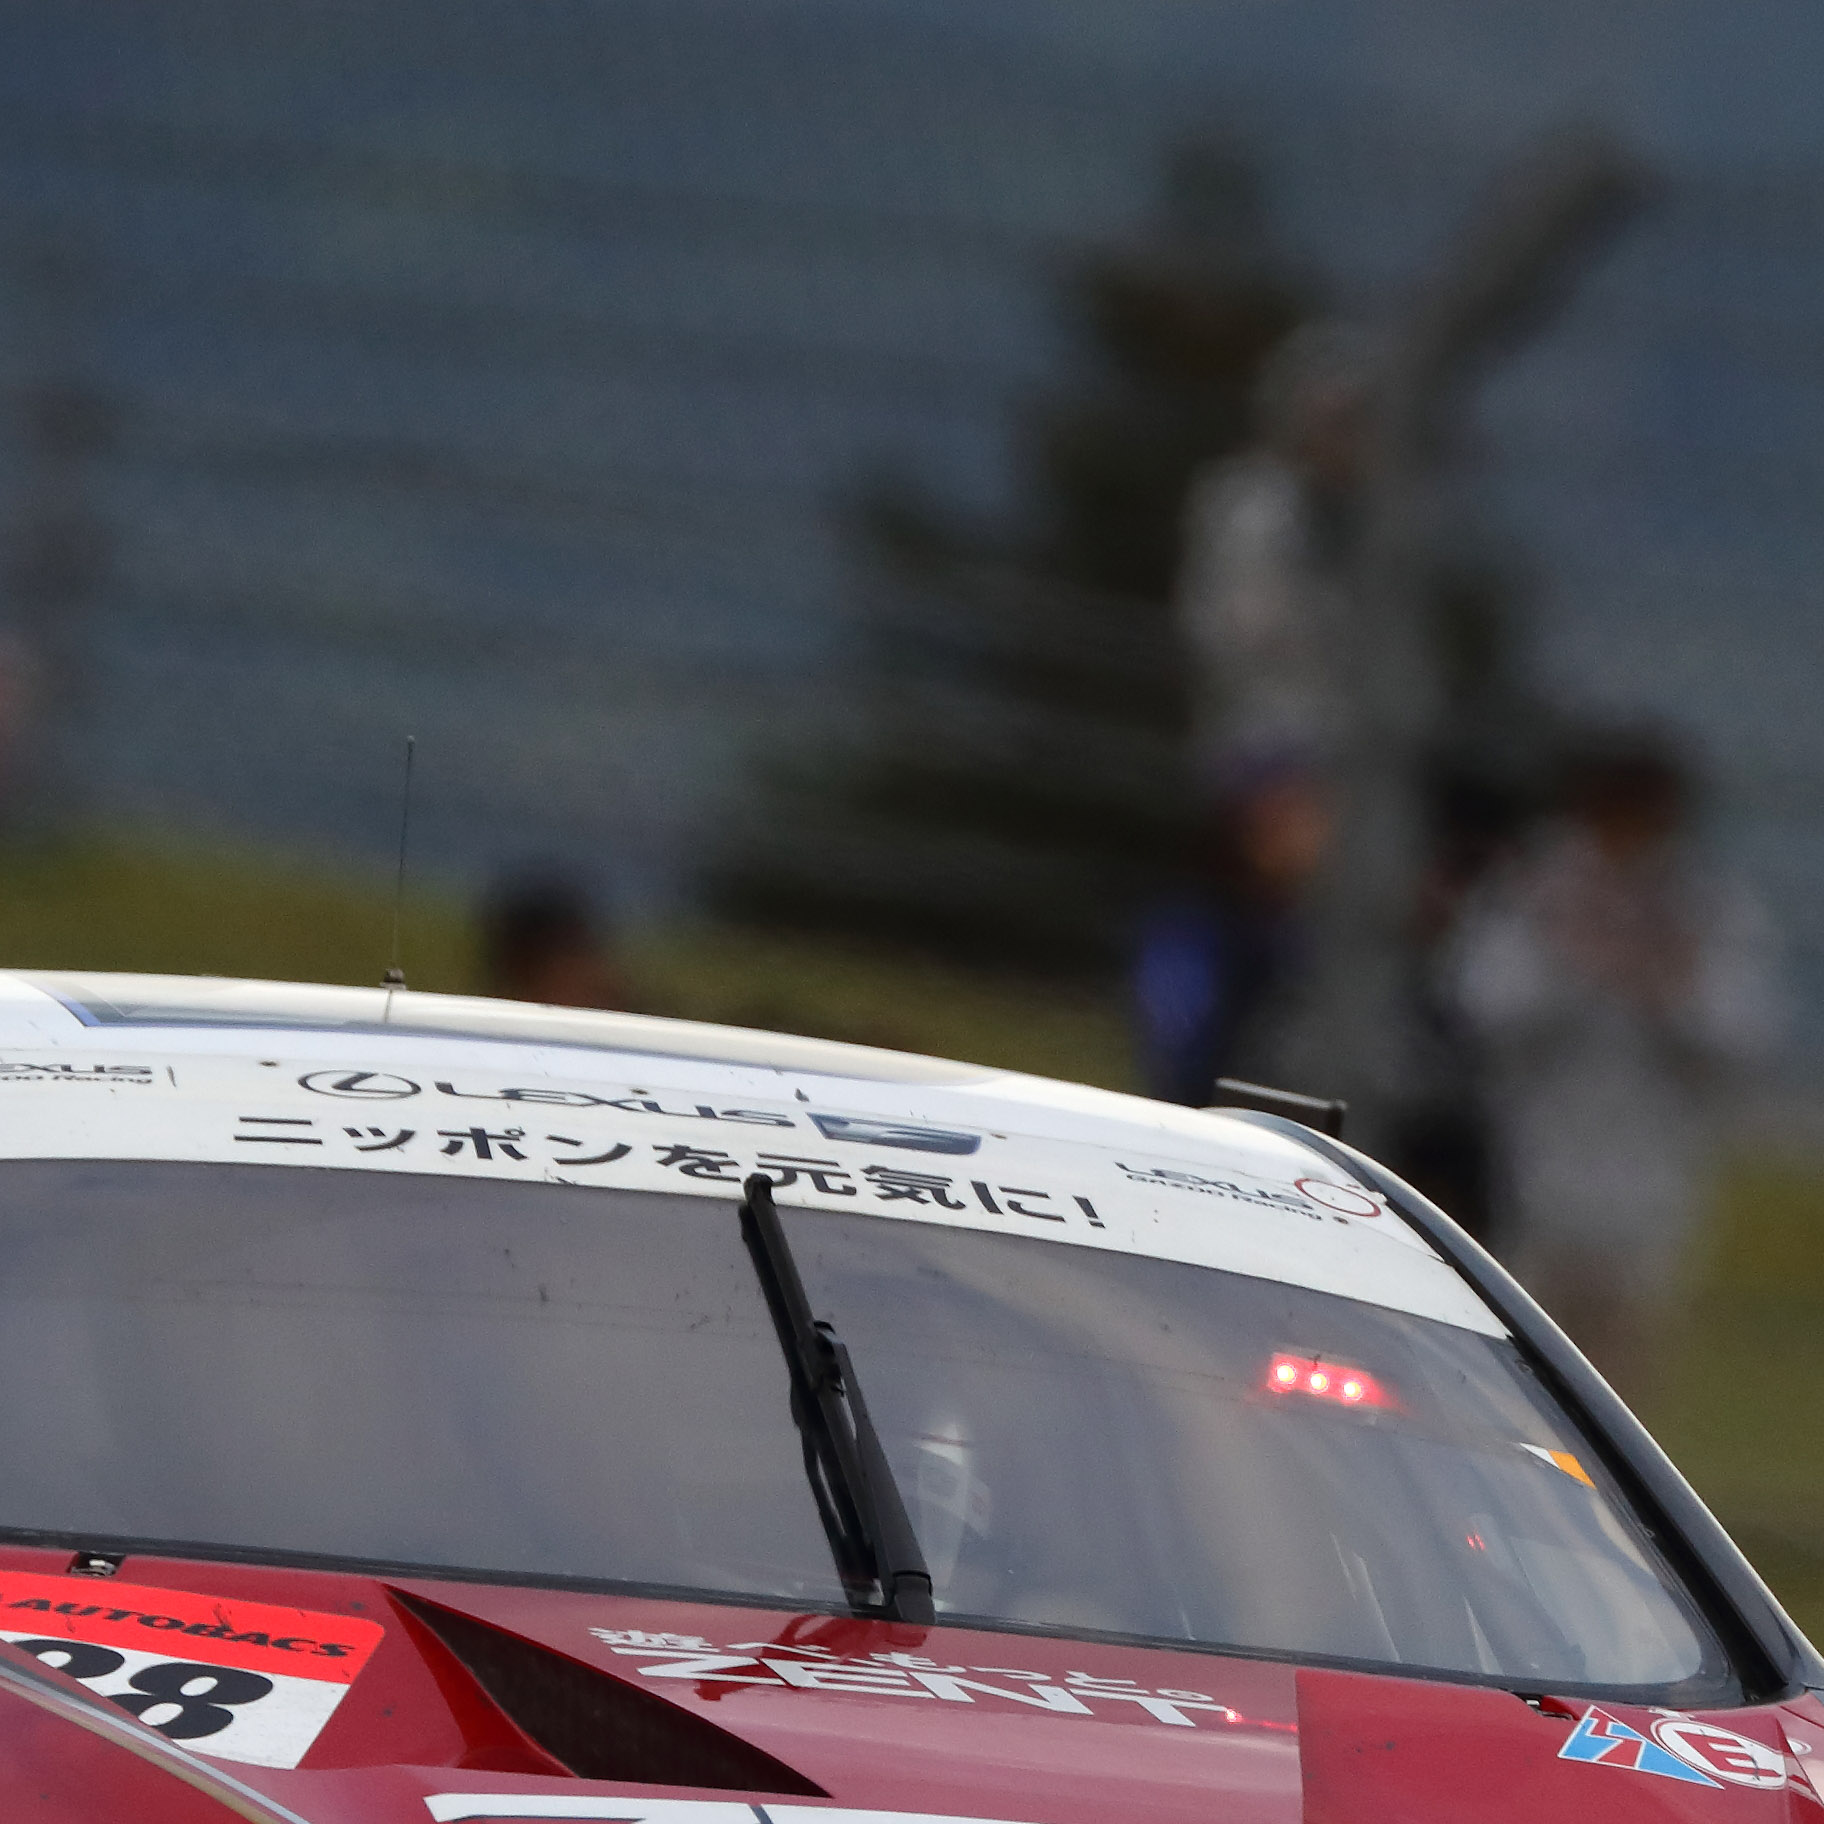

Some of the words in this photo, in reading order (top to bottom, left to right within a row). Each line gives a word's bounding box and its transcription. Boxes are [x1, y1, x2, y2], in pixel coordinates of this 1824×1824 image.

[434, 1081, 798, 1127] LEXUS
[7, 1597, 357, 1658] AUTOBACS
[612, 1647, 1227, 1728] ZENT
